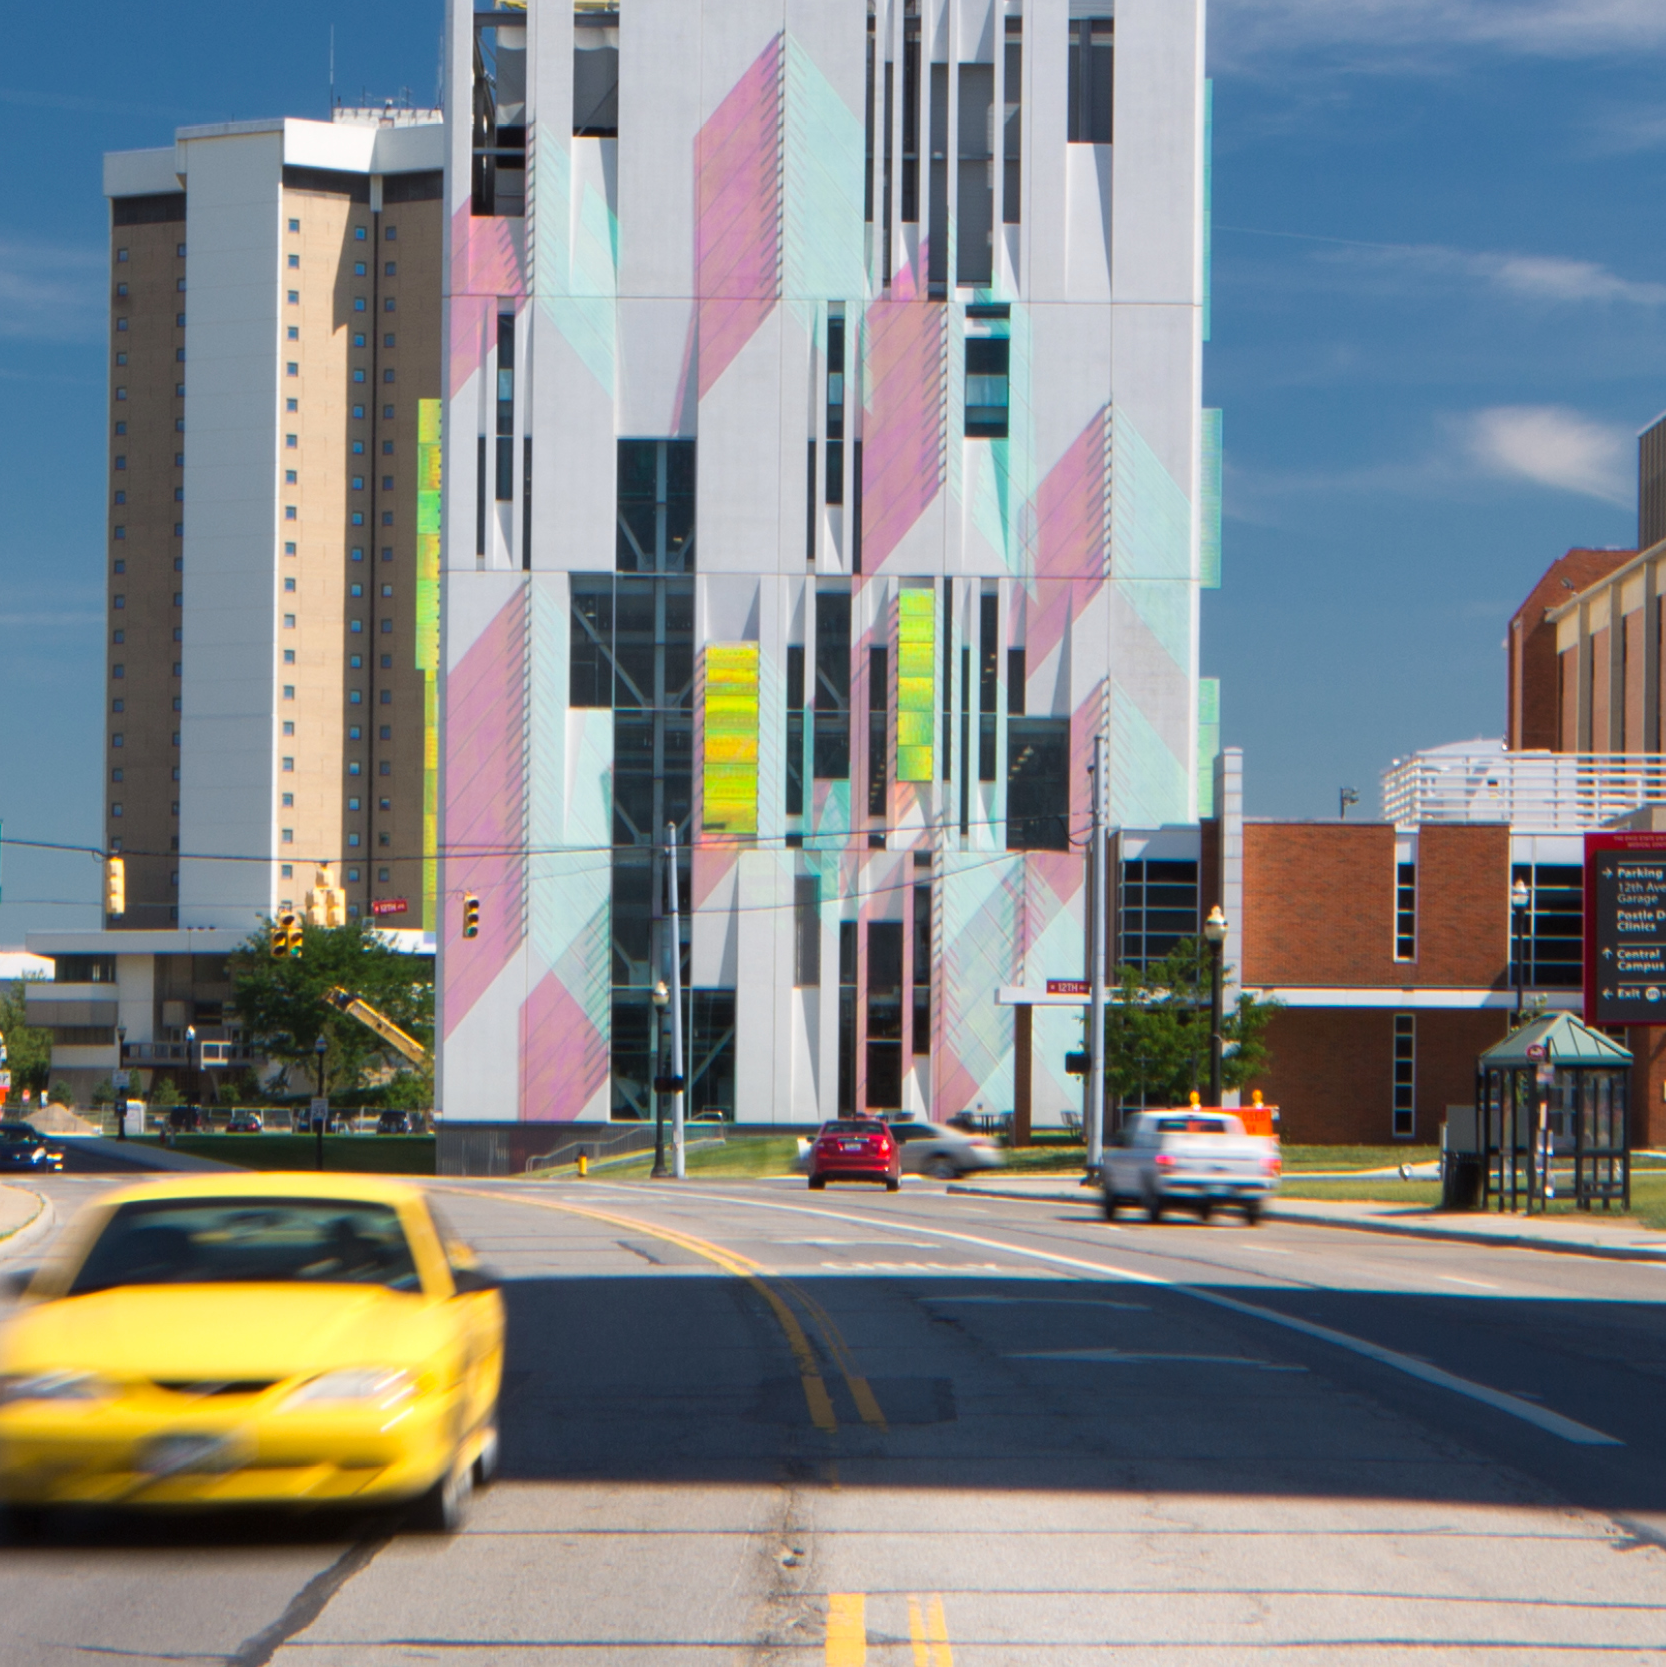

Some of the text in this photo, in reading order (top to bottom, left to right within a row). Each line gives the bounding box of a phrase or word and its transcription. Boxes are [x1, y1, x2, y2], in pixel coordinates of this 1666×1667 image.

[1617, 867, 1664, 881] Parking
[1618, 881, 1644, 893] 12th
[1617, 893, 1659, 906] Garage
[1617, 909, 1654, 922] Postle
[1617, 922, 1657, 933] Clinics
[1617, 948, 1661, 960] Central
[1617, 960, 1666, 973] Campus
[1058, 982, 1078, 992] 12TH
[1617, 987, 1641, 1000] Exit
